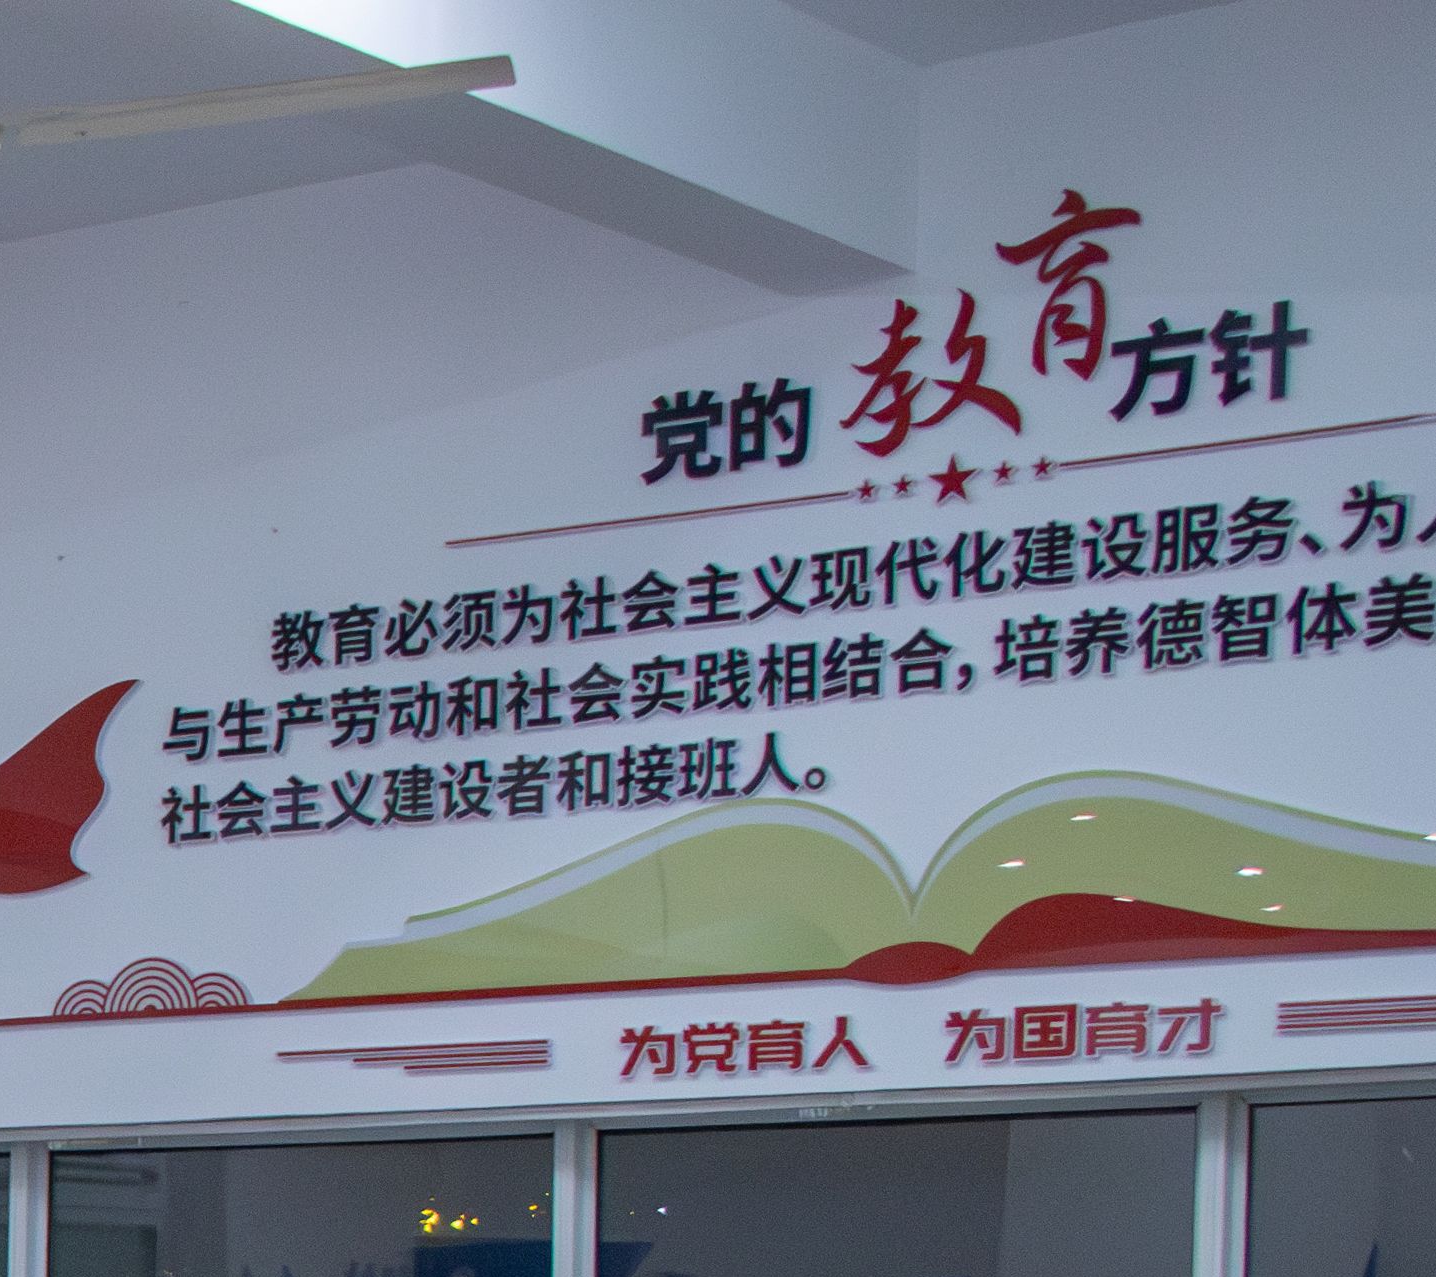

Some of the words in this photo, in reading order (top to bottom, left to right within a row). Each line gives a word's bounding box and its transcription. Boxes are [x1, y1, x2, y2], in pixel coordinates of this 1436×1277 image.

[641, 187, 1310, 486] 党的教育方针
[270, 481, 1436, 673] 教育必须为社会主义现代化建设服务、为
[160, 731, 827, 845] 社会主义建设者和接班人。
[619, 1015, 867, 1076] 为党育人
[947, 999, 1223, 1061] 为国育才
